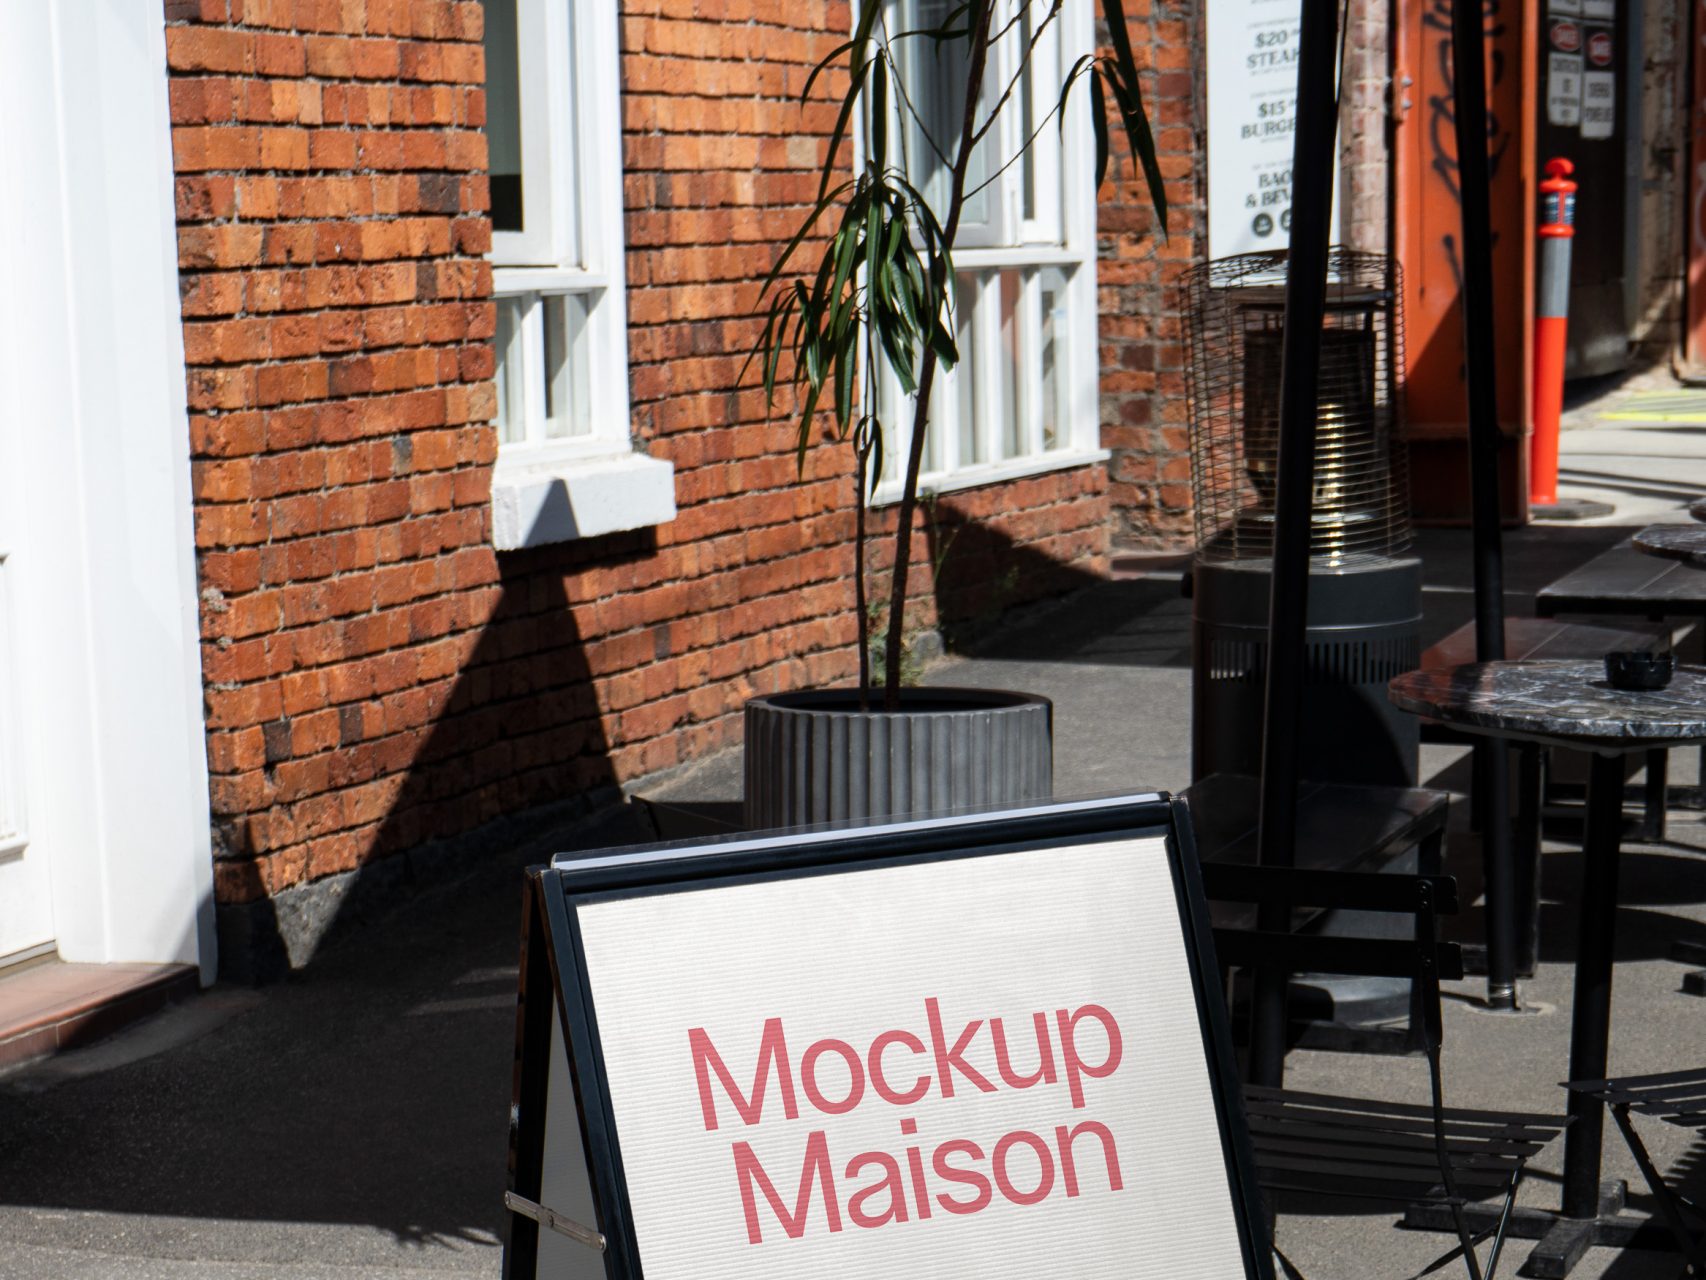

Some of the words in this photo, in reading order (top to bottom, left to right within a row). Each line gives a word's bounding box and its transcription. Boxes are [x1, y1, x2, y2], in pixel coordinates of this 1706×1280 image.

[1255, 30, 1288, 48] $20
[1258, 100, 1285, 118] $15
[1241, 119, 1295, 139] BURGE
[1245, 193, 1257, 208] &
[1261, 188, 1291, 206] BEV
[688, 998, 1123, 1130] Mockup
[732, 1118, 1123, 1244] Maison
